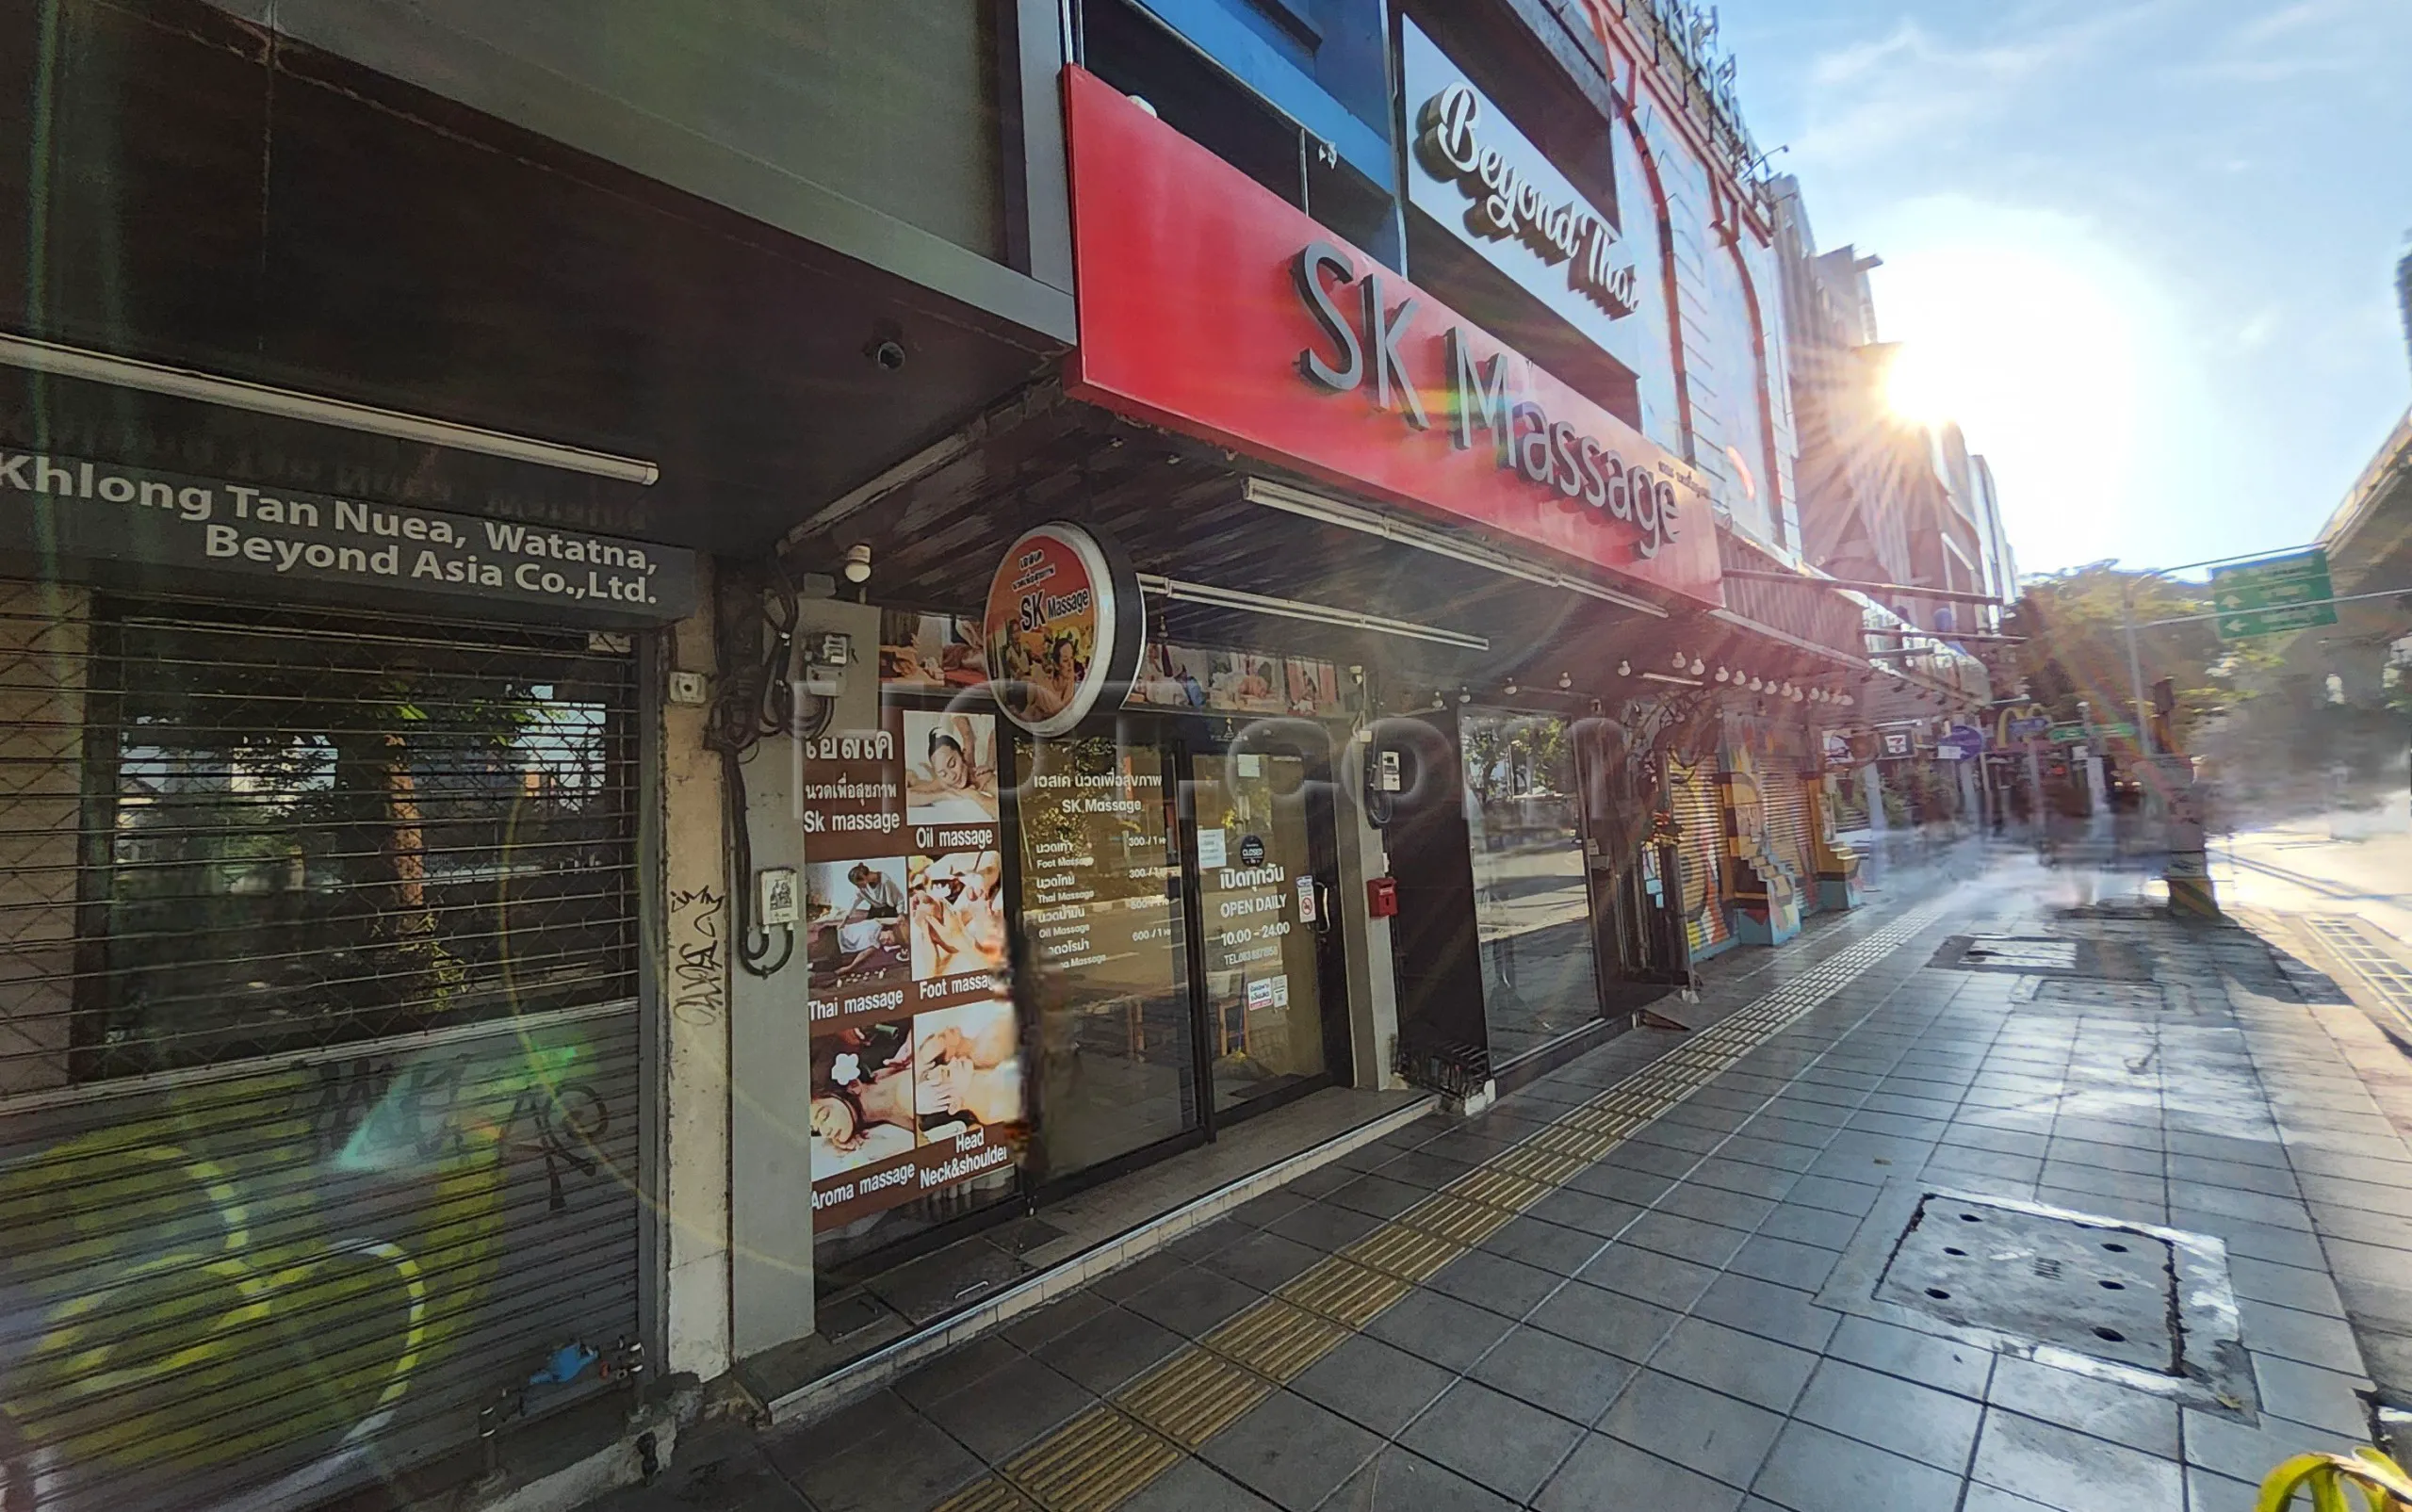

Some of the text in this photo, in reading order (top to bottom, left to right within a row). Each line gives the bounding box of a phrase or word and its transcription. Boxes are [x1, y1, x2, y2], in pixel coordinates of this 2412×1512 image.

[1436, 81, 1640, 313] Beyond Thai
[1295, 240, 1681, 560] SK Massage
[0, 452, 658, 575] Khlong Tan Nuea, Watatna,
[205, 524, 657, 604] Beyond Asia Co.,Ltd.
[1020, 589, 1089, 632] SK Massage
[805, 772, 897, 806] นวดเพื่อสุขภาพ
[1061, 798, 1142, 814] SK Massage
[804, 810, 901, 834] Sk massage
[916, 827, 993, 849] Oil massage
[1036, 859, 1056, 869] Foot
[1242, 848, 1263, 856] CLOSED
[1219, 862, 1285, 892] เปิดทุกวัน
[1037, 890, 1095, 903] Thai Massage
[1220, 893, 1287, 919] OPEN DAILY
[1038, 923, 1090, 938] Oil Massage
[1220, 928, 1251, 946] 10.00
[1262, 921, 1291, 938] 24.00
[1070, 954, 1106, 967] Massage
[920, 974, 993, 1000] Foot massag
[807, 989, 904, 1021] Thai massage
[955, 1128, 985, 1153] Head
[811, 1162, 915, 1210] Aroma massage
